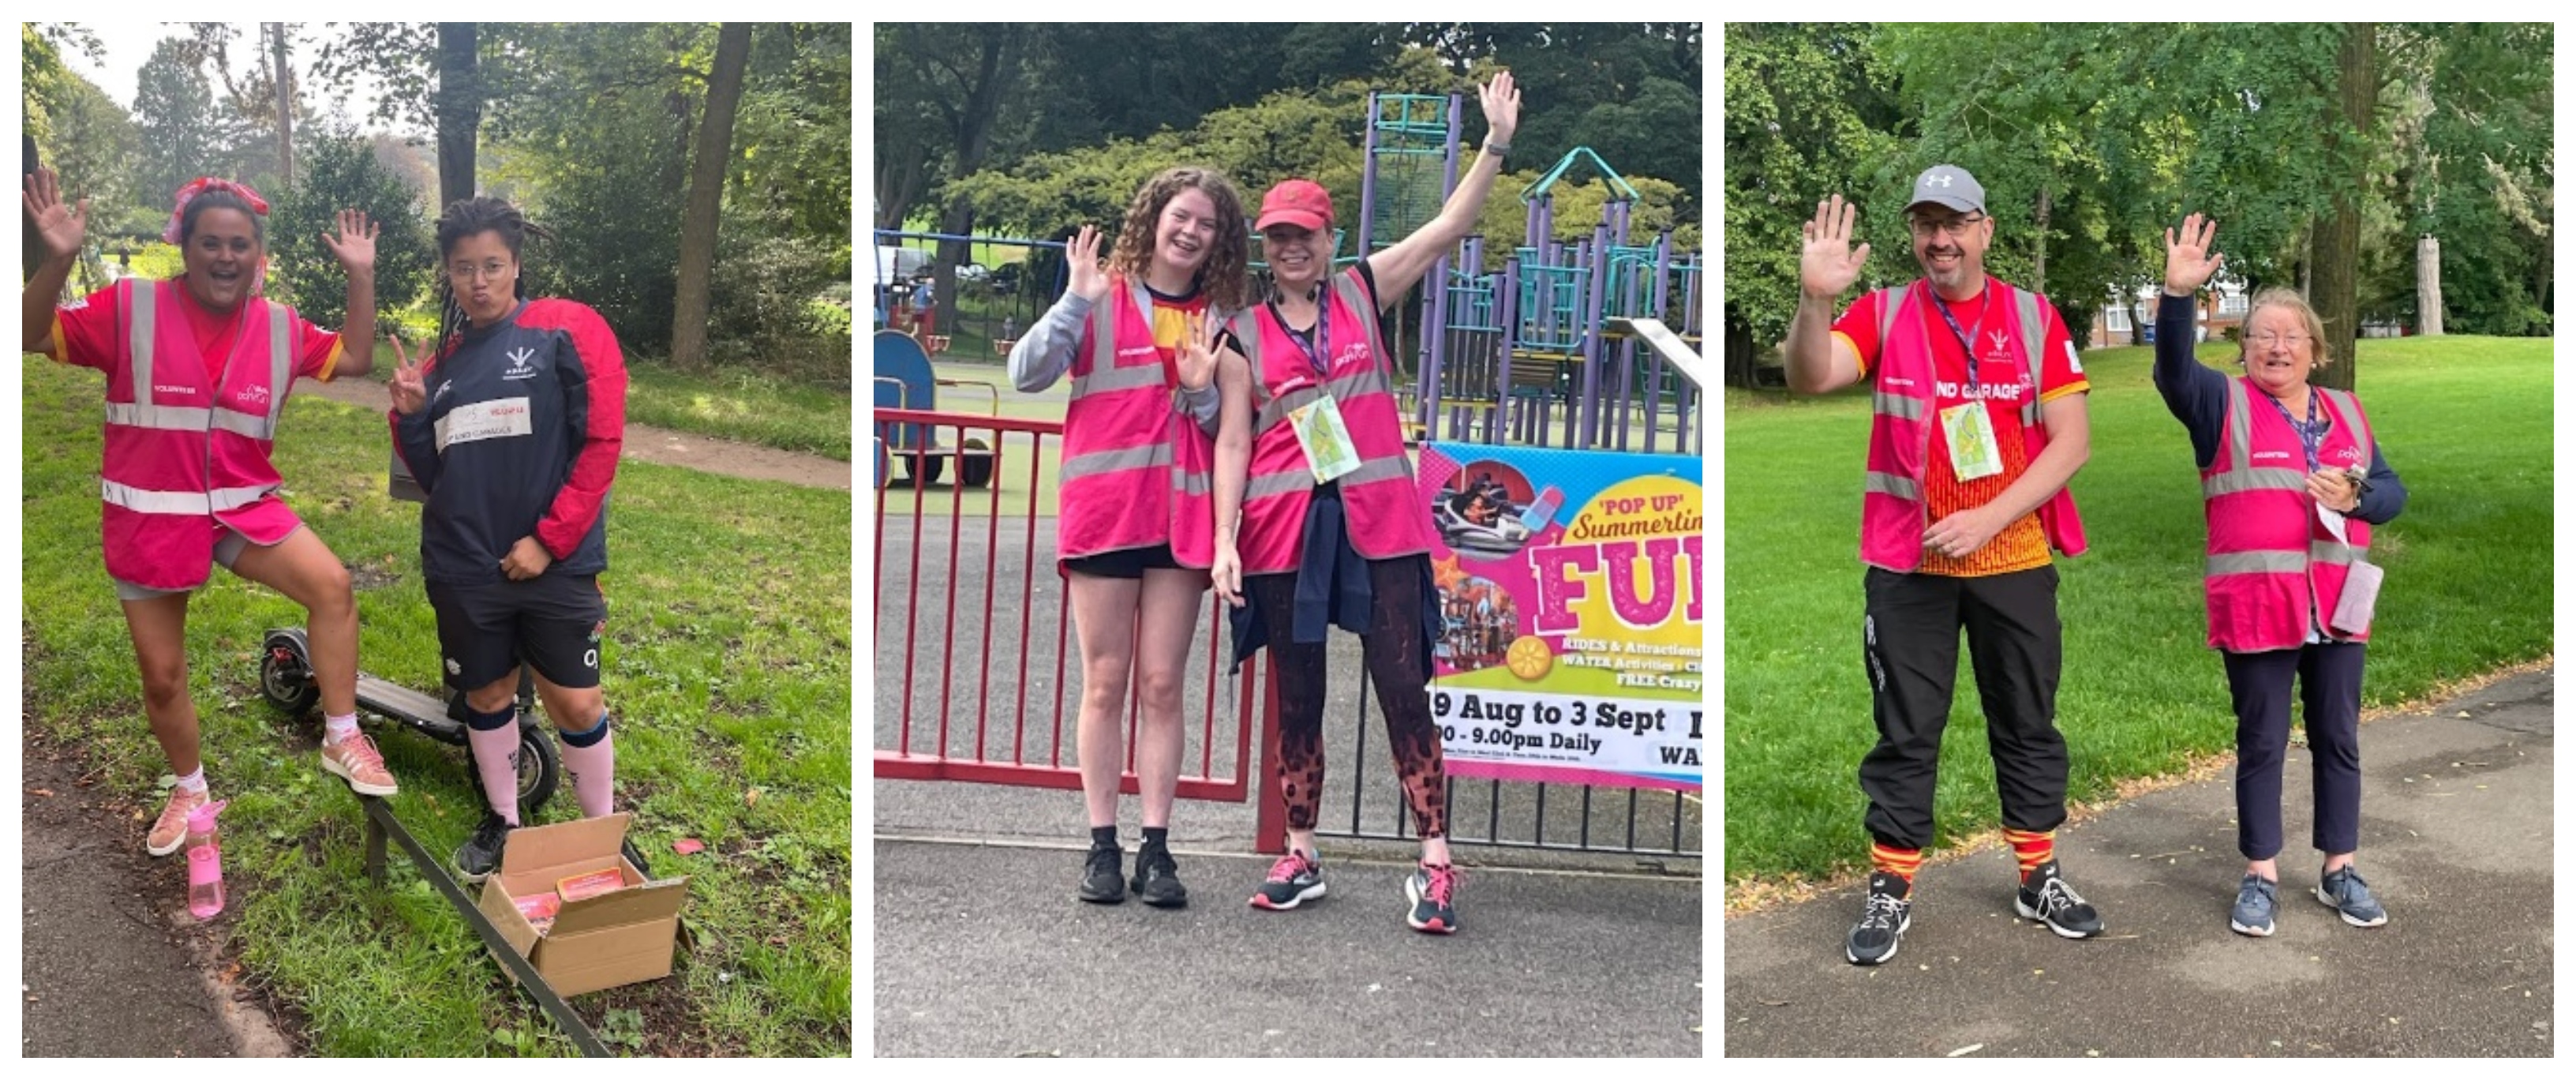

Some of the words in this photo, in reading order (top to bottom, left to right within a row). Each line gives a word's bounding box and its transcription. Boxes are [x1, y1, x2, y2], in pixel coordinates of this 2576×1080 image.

[1599, 497, 1646, 516] 'POP
[1650, 493, 1684, 512] UP'
[1562, 638, 1608, 651] RIDES
[1611, 640, 1622, 652] &
[1625, 641, 1702, 658] Attractions
[1563, 654, 1612, 668] WATER
[1615, 658, 1675, 672] Activities
[1616, 673, 1657, 686] FREE
[1659, 674, 1702, 692] Crazy
[1459, 694, 1526, 728] Aug
[1533, 700, 1562, 725] to
[1570, 700, 1587, 726] 3
[1595, 702, 1666, 736] Sept
[1472, 727, 1544, 751] 9.00pm
[1550, 732, 1602, 756] Daily
[1660, 745, 1702, 767] WA
